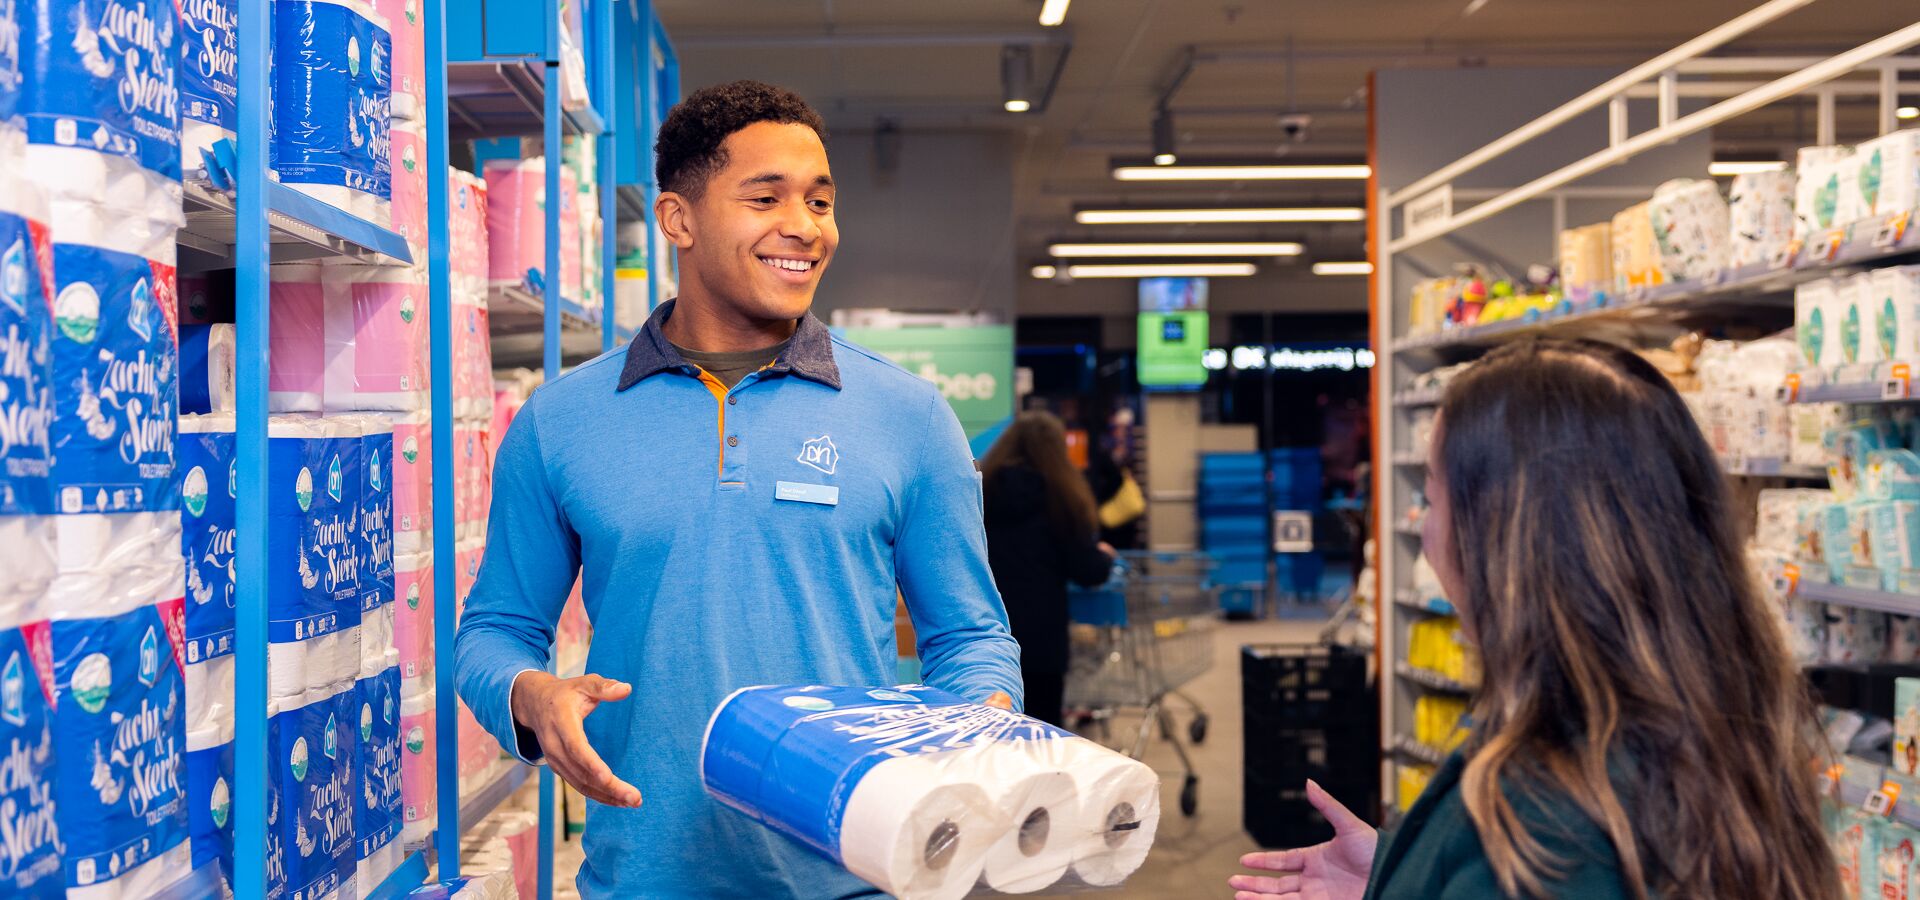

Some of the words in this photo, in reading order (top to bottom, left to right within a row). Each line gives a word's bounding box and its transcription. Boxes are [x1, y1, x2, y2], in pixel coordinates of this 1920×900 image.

[198, 28, 238, 78] Ster
[119, 48, 178, 127] Sterk
[99, 348, 154, 410] Zacht
[119, 397, 176, 469] Sterk
[312, 514, 346, 558] Zacht
[361, 502, 386, 543] Zacht
[324, 544, 361, 594] Sterk
[369, 531, 394, 574] Sterk
[110, 698, 159, 768] Zacht
[373, 736, 395, 778] Zacht
[128, 736, 186, 818] Sterk
[310, 772, 343, 821] Zacht
[322, 795, 356, 855] Sterk
